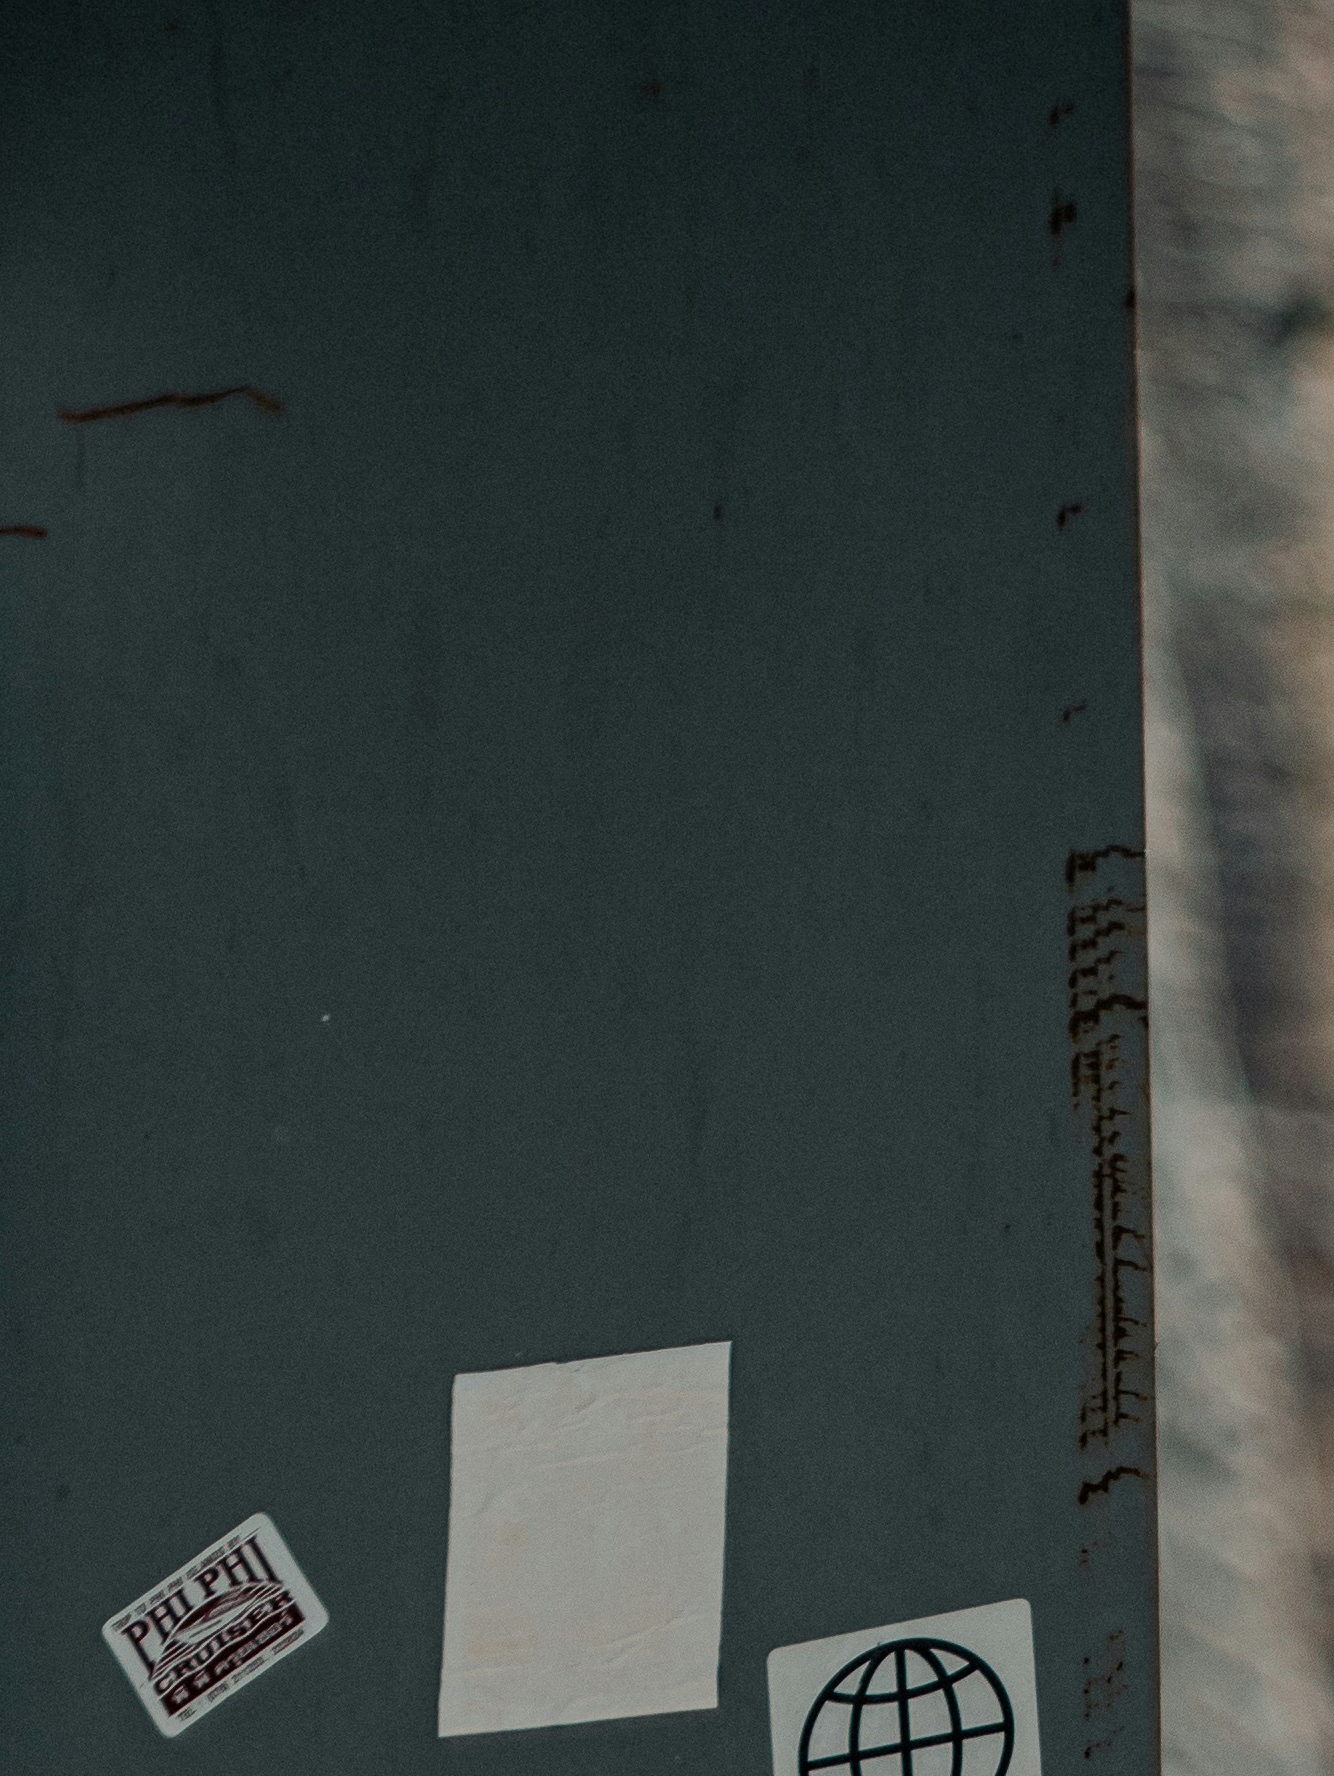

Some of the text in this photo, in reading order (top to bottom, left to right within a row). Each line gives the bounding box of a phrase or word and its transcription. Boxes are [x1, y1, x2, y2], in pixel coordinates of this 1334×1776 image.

[120, 1536, 283, 1682] PHI PHI
[154, 1589, 295, 1695] CRUISER
